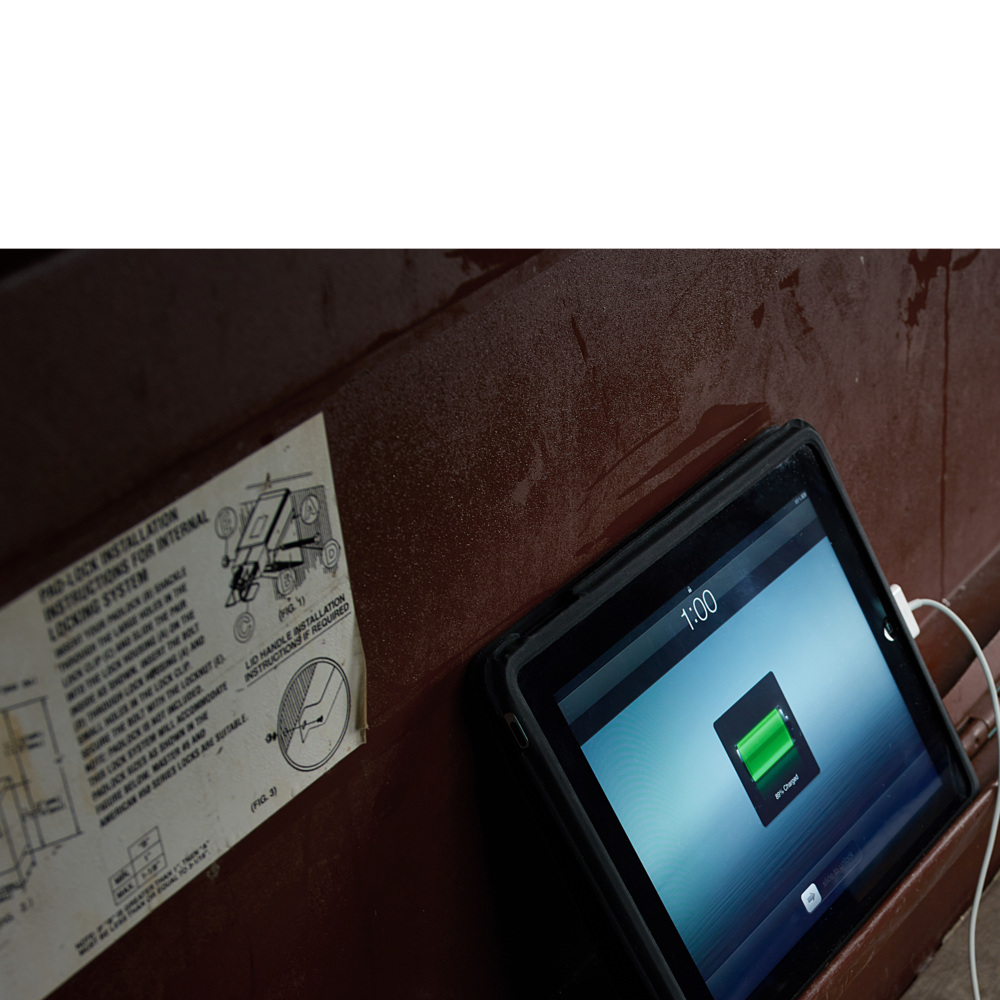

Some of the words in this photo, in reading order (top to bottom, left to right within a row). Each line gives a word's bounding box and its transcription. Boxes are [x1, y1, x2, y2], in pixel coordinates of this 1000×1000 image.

[39, 558, 98, 602] PAD-LOCK
[100, 508, 178, 564] INSTALLATION
[44, 559, 129, 621] INSTRUCTIONS
[131, 543, 155, 566] FOR
[156, 511, 209, 551] INTERNAL
[48, 599, 100, 641] LOCKING
[102, 568, 148, 607] SYSTEM
[84, 620, 105, 636] YOUR
[107, 597, 141, 622] PADLOCK
[97, 633, 112, 645] THE
[114, 616, 138, 636] LARGE
[139, 599, 163, 619] HOLES
[164, 593, 172, 603] IN
[173, 583, 186, 596] THE
[244, 634, 302, 682] INSTRUCTIONS
[302, 629, 309, 641] IF
[311, 602, 349, 634] REQUIRED
[245, 655, 258, 670] LID
[259, 630, 292, 659] HANDLE
[293, 593, 345, 636] INSTALLATION
[681, 590, 718, 630] 1:00
[63, 669, 83, 687] LOCK
[115, 636, 131, 652] AND
[154, 612, 168, 624] THE
[86, 674, 100, 686] THE
[103, 659, 122, 678] LOCK
[122, 636, 156, 663] HOUSING
[169, 620, 180, 633] ON
[181, 610, 194, 623] THE
[87, 691, 123, 719] THROUGH
[125, 677, 144, 696] LOCK
[190, 635, 204, 650] AND
[97, 685, 107, 698] AS
[167, 636, 180, 649] THE
[181, 622, 199, 640] BOLT
[81, 734, 110, 758] SECURE
[112, 723, 125, 735] THE
[127, 708, 144, 727] BOLT
[145, 695, 165, 713] WITH
[166, 684, 179, 698] THE
[180, 661, 212, 689] LOCKNUT
[88, 769, 106, 785] THIS
[106, 755, 126, 773] LOCK
[127, 732, 156, 758] SYSTEM
[157, 721, 175, 737] WILL
[176, 681, 227, 723] ACCOMMODATE
[104, 704, 129, 725] HOLES
[129, 697, 138, 708] IN
[139, 687, 153, 700] THE
[154, 673, 173, 691] LOCK
[108, 727, 141, 755] PADLOCK
[151, 710, 165, 726] NOT
[92, 771, 126, 800] PADLOCK
[148, 747, 158, 759] AS
[159, 728, 186, 752] SHOWN
[186, 721, 194, 732] IN
[194, 711, 208, 725] THE
[100, 795, 137, 827] AMERICAN
[151, 765, 176, 789] SERIES
[177, 748, 200, 770] LOCKS
[200, 737, 214, 753] ARE
[215, 714, 246, 742] SUITABLE.
[151, 746, 181, 772] MASTER
[191, 728, 206, 744] AND
[783, 773, 800, 791] Charged
[250, 794, 268, 813] (FIG.
[124, 884, 154, 911] GREATER
[154, 871, 172, 885] THAN
[127, 901, 145, 916] THAN
[146, 891, 156, 902] OR
[156, 877, 178, 894] EQUAL
[178, 867, 187, 875] TO
